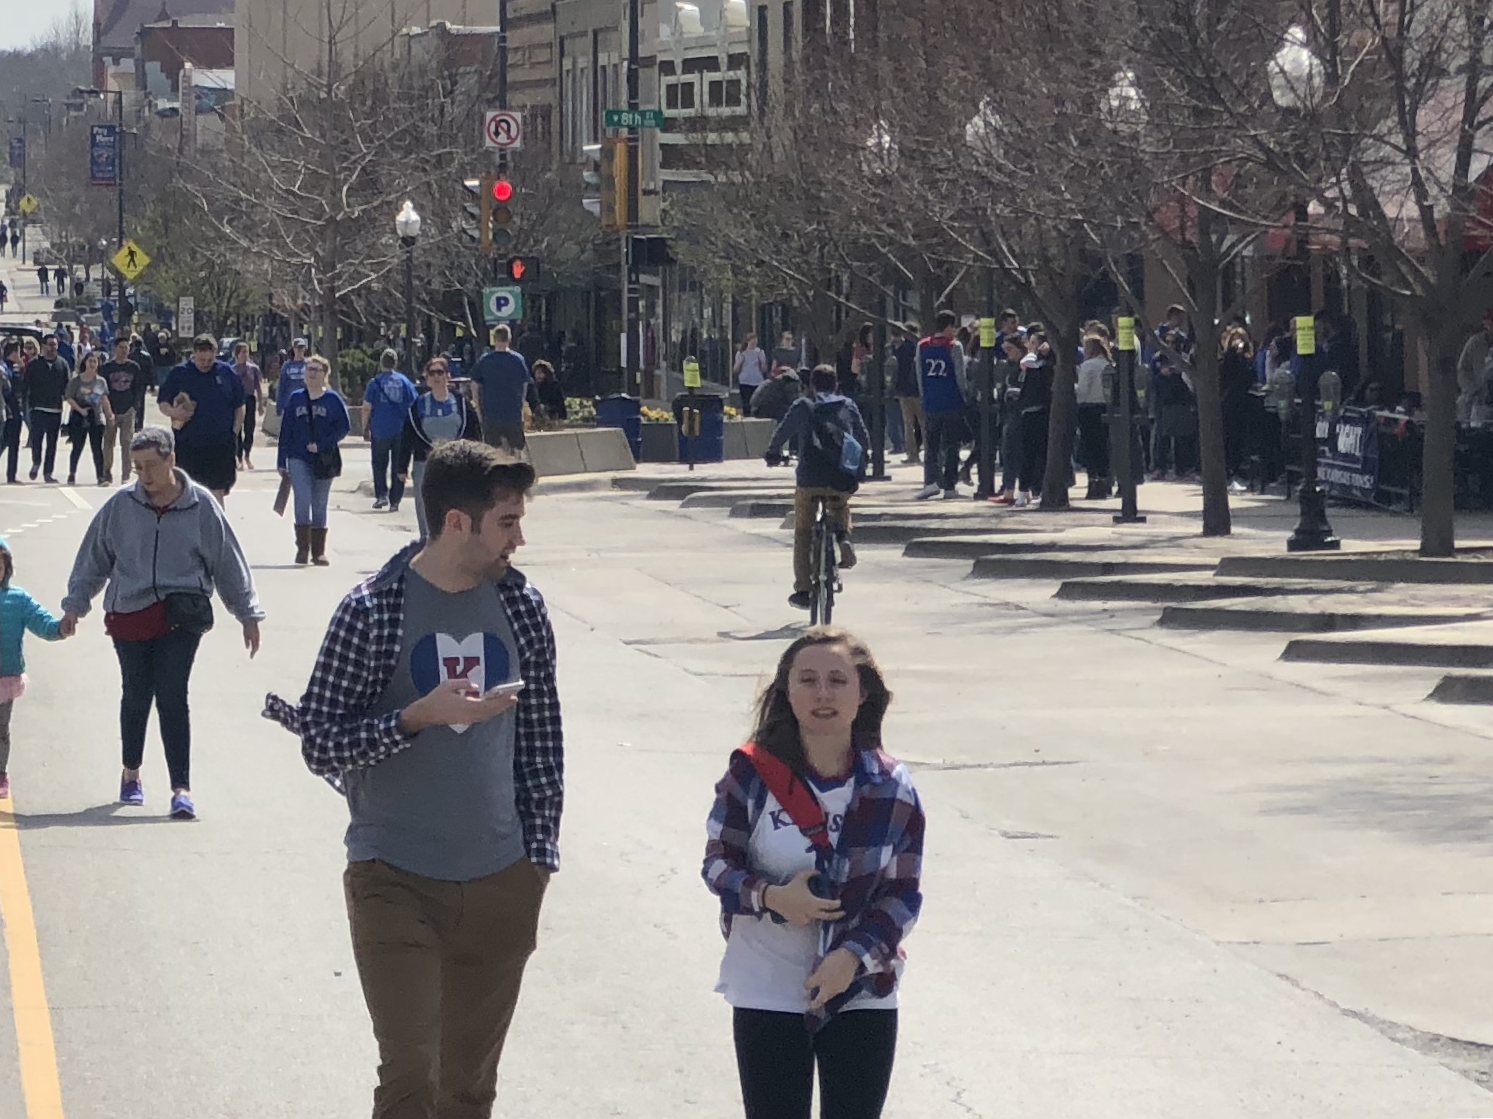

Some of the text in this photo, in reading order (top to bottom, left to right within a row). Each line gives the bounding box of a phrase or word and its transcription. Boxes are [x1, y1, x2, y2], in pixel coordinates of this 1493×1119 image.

[621, 112, 642, 126] 8th
[495, 296, 510, 312] P
[925, 358, 947, 377] 22
